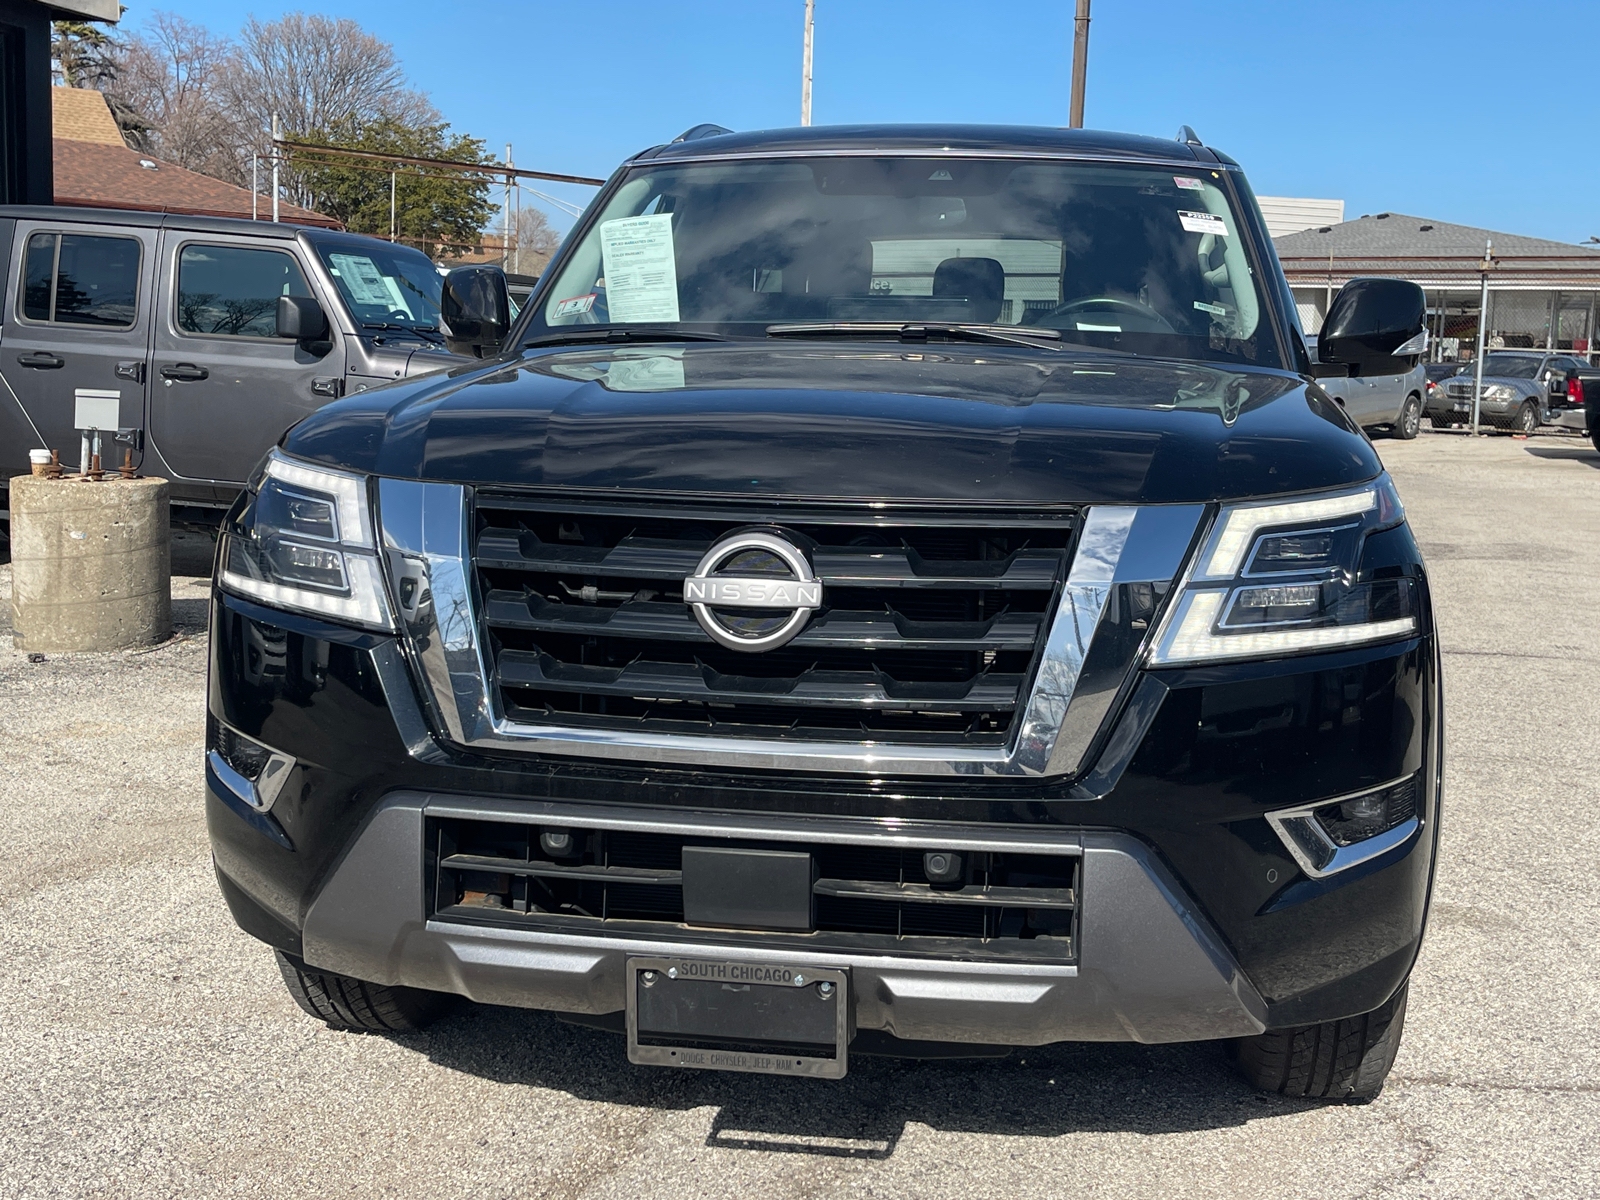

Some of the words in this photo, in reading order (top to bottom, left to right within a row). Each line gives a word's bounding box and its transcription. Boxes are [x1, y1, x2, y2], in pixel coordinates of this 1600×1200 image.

[687, 582, 818, 603] NISSAN
[681, 963, 727, 979] SOUTH
[730, 965, 792, 983] CHICAGO
[711, 1054, 747, 1067] CHRYSLER
[752, 1058, 771, 1069] JEEP
[776, 1060, 792, 1071] RAM
